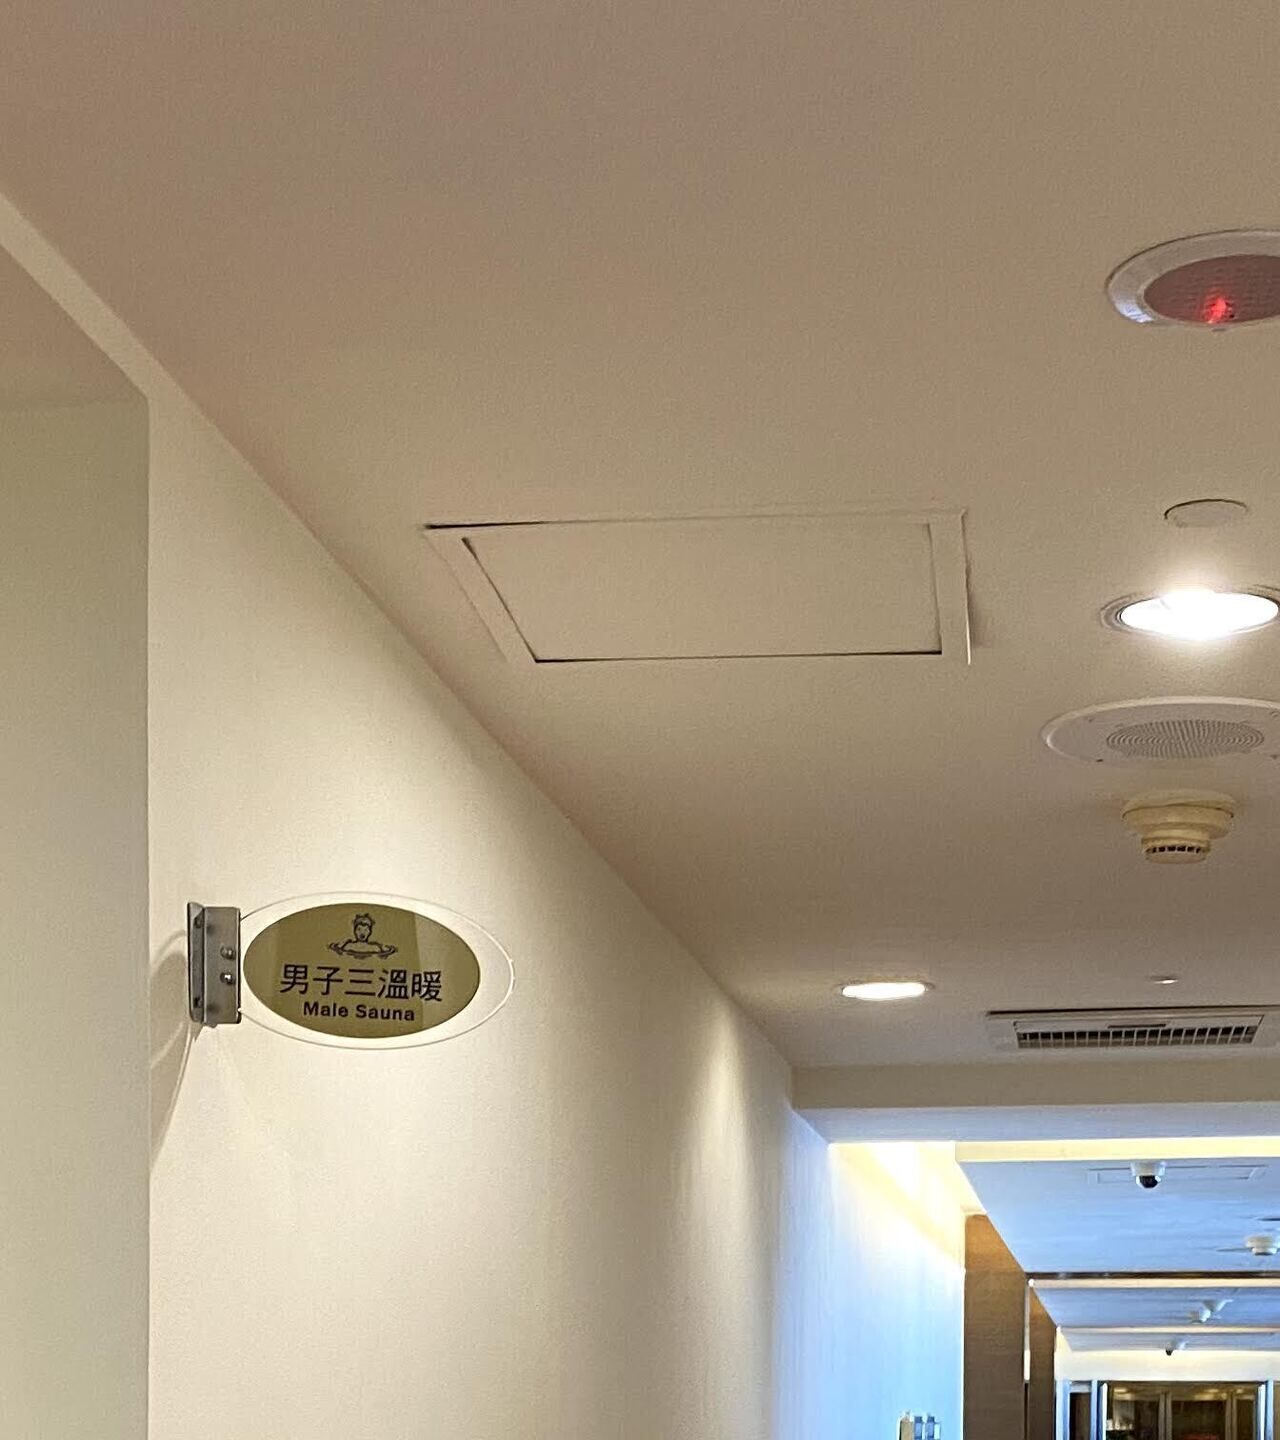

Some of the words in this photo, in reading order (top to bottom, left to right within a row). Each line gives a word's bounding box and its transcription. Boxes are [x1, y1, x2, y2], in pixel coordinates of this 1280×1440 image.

[280, 964, 443, 1002] 男子三溫暖
[303, 1001, 348, 1018] Male
[356, 1004, 415, 1021] Sauna
